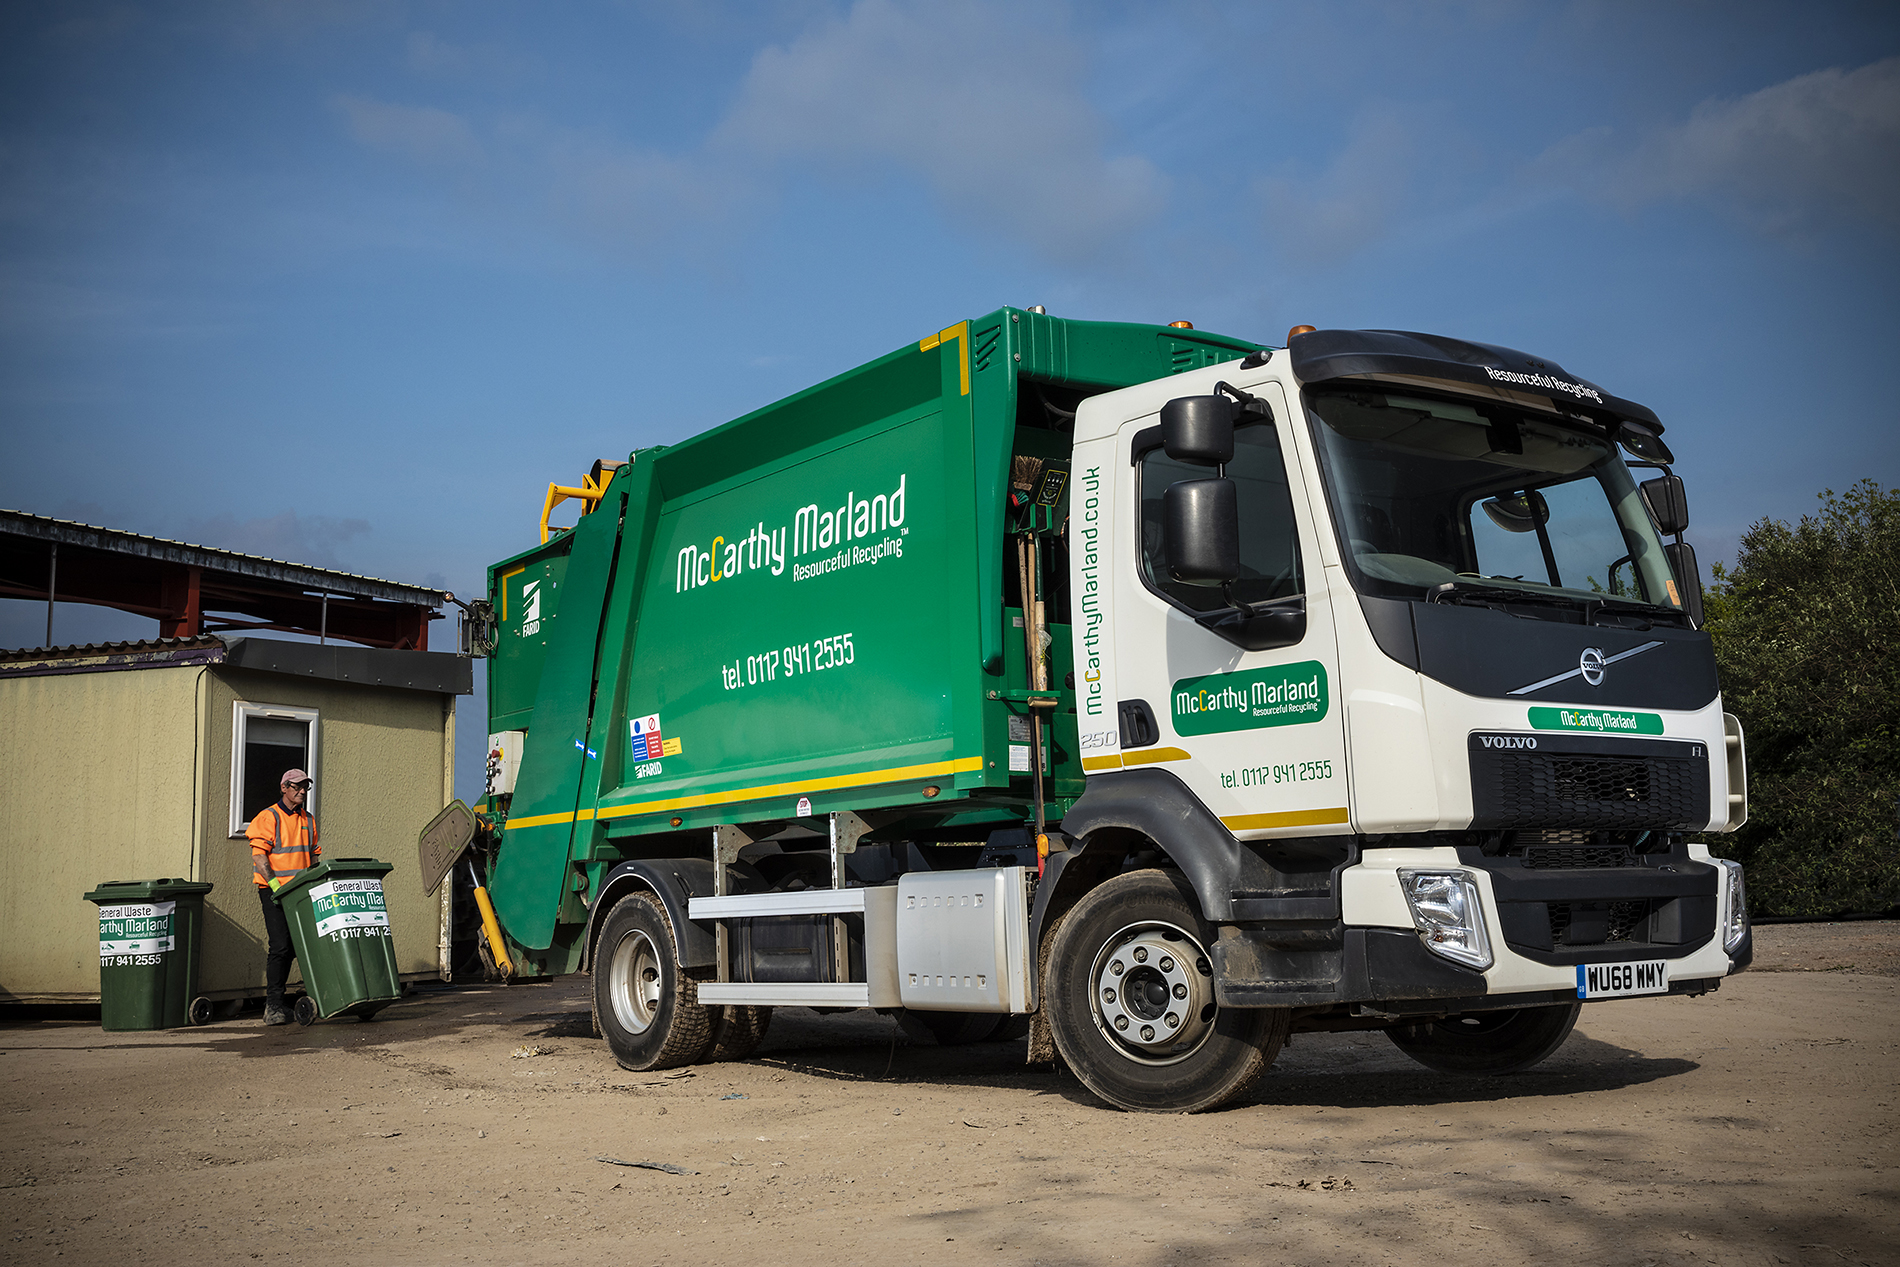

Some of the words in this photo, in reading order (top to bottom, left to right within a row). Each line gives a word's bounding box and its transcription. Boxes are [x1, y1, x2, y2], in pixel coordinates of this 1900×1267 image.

[1484, 366, 1554, 388] Resourceful
[1551, 376, 1603, 404] Recycling
[676, 522, 786, 594] McCarthy
[794, 474, 906, 557] Marland
[794, 549, 850, 582] Resourceful
[852, 536, 903, 565] Recycling
[1082, 466, 1102, 716] McCarthyMarland.co.uk
[523, 620, 540, 638] FARID
[722, 660, 744, 690] tel.
[747, 650, 780, 686] 0117
[783, 643, 811, 677] 941
[814, 633, 854, 670] 2555
[1176, 686, 1248, 715] McCarthy
[1252, 675, 1318, 706] Marland
[1252, 704, 1288, 716] Resourceful
[1289, 702, 1318, 713] Recycling
[1560, 711, 1604, 730] McCarthy
[1603, 713, 1637, 729] Marland
[1080, 730, 1118, 750] 250
[1479, 736, 1538, 750] VOLVO
[642, 762, 662, 778] FARID
[1220, 770, 1240, 788] tel.
[1242, 767, 1270, 786] 0117
[1273, 764, 1296, 784] 941
[1299, 760, 1332, 782] 2555
[332, 881, 362, 892] General
[364, 880, 383, 892] Wast
[124, 906, 152, 917] Waste
[317, 893, 366, 912] McCarthy
[126, 916, 168, 932] Marland
[330, 932, 338, 942] T:
[340, 928, 362, 939] 0117
[364, 927, 380, 937] 941
[116, 955, 133, 967] 941
[135, 954, 162, 966] 2555
[1588, 965, 1632, 992] WU68
[1636, 962, 1665, 988] WMY
